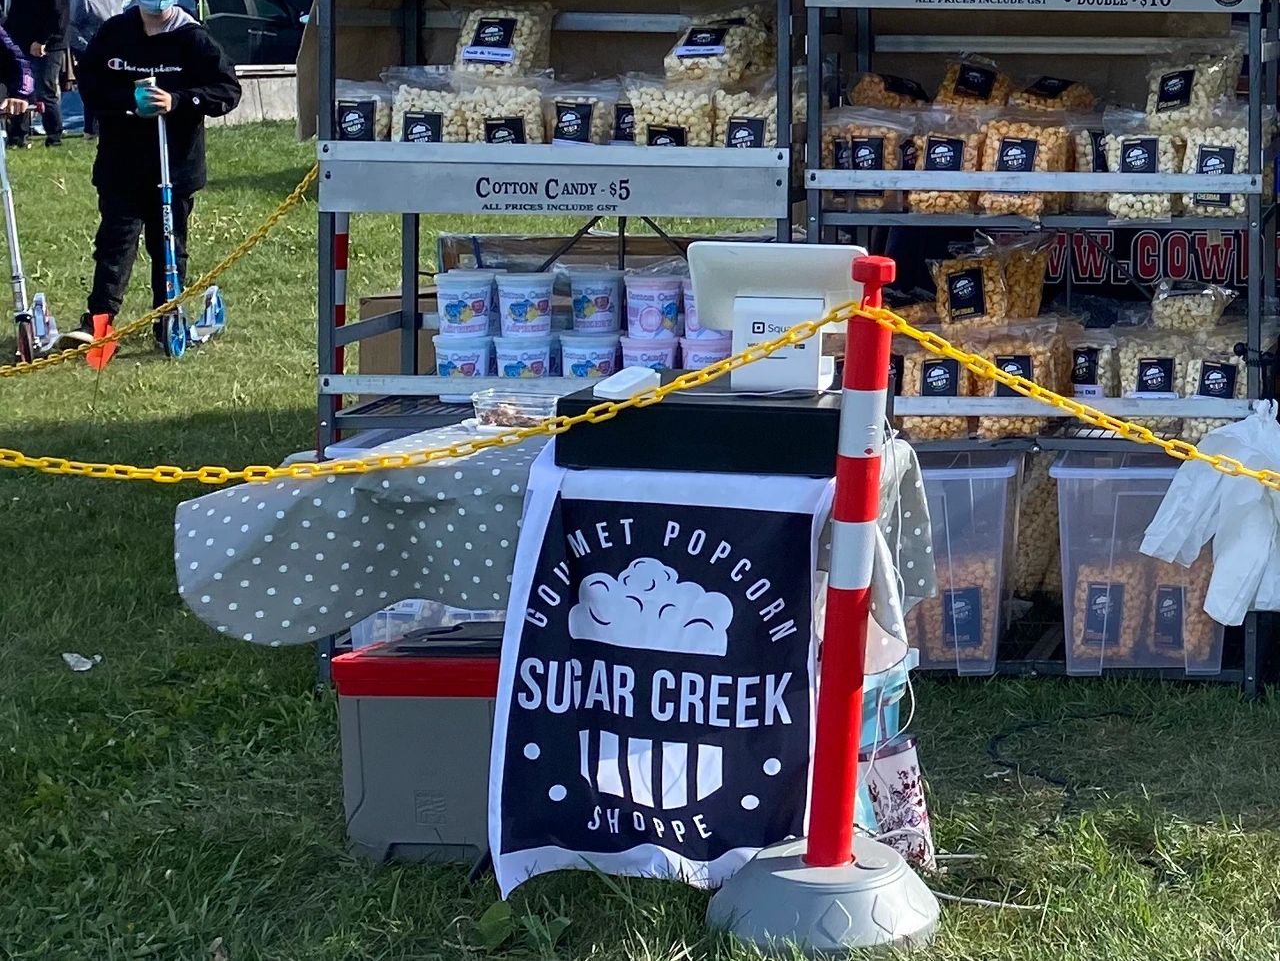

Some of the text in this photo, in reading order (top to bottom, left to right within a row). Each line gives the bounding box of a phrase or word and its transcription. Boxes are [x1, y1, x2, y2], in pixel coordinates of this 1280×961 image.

[107, 58, 183, 77] Champion
[476, 177, 539, 199] COTTON
[545, 179, 598, 200] CANDY
[609, 179, 631, 200] $5
[482, 203, 618, 212] ALL PRICES INCLUDE GST
[664, 520, 798, 642] POPCORN
[651, 670, 793, 729] CREEK
[587, 804, 712, 844] SHOPPE
